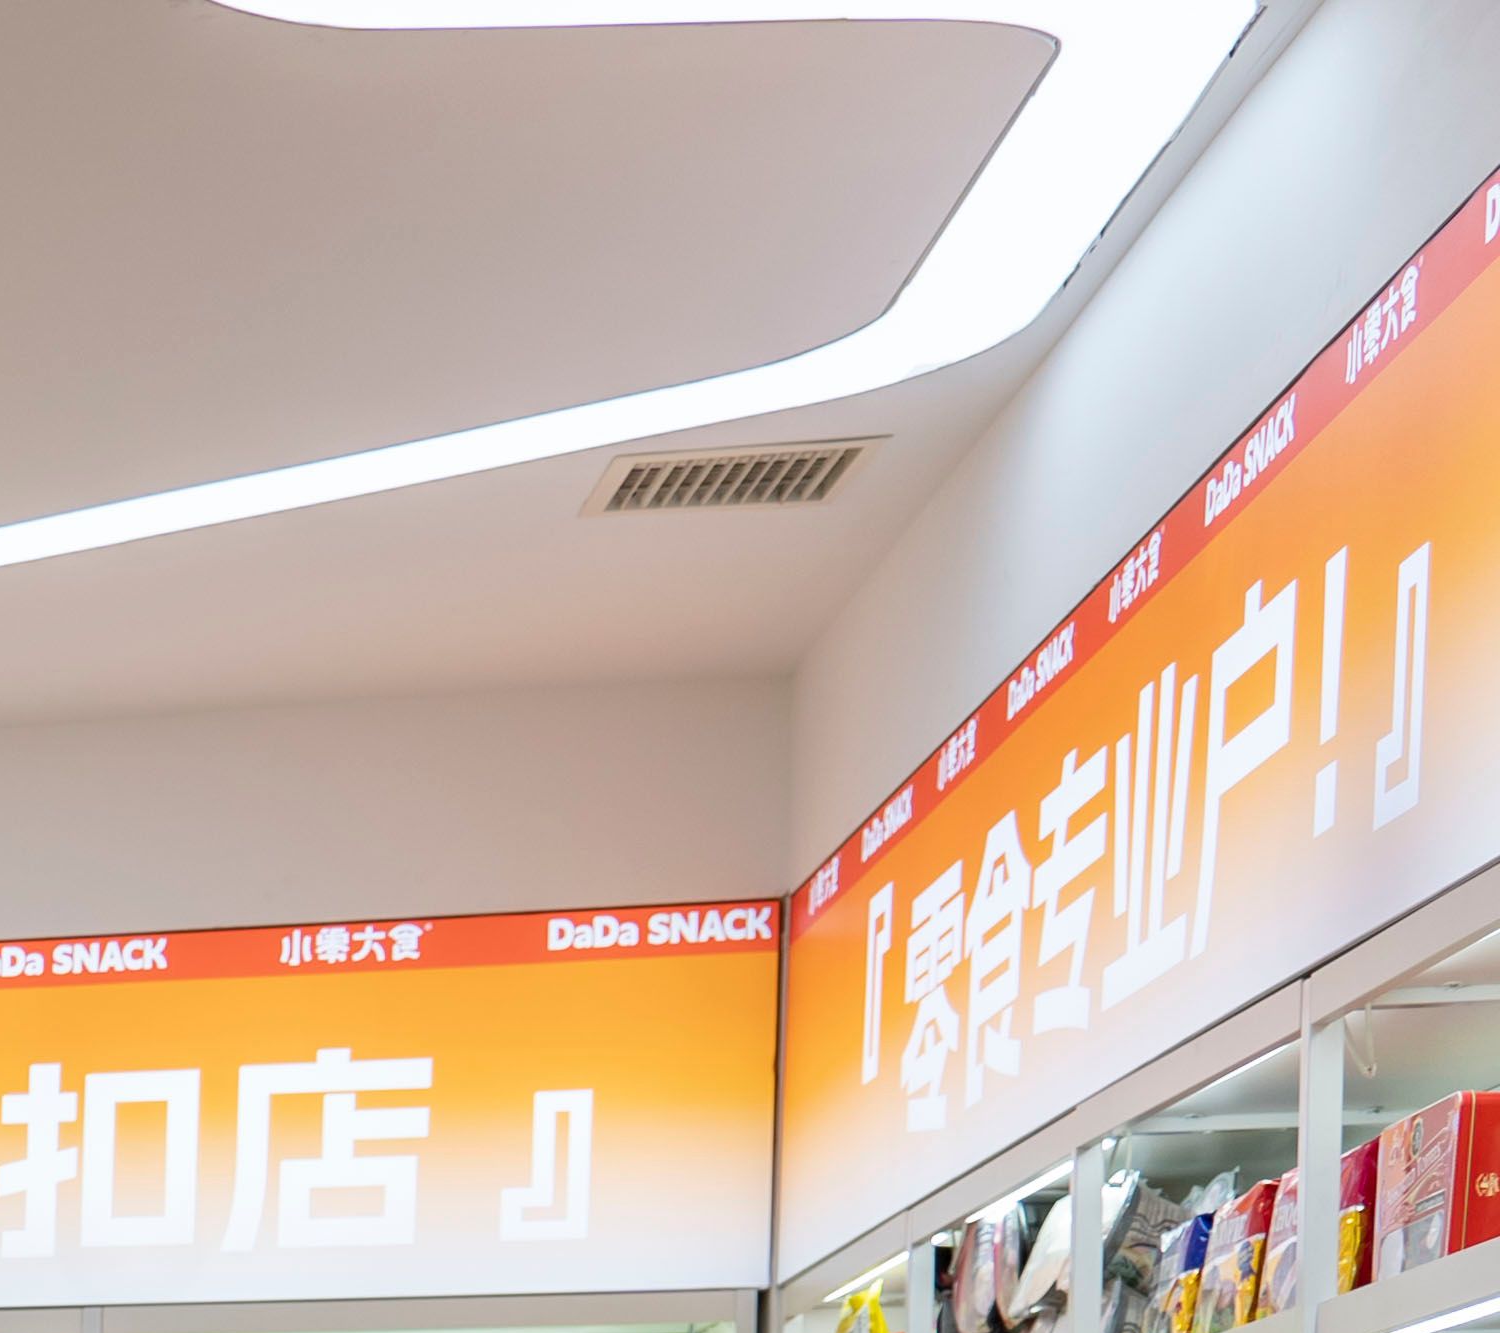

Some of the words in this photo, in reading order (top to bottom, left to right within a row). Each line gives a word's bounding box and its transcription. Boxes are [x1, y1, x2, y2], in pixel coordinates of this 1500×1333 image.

[1345, 265, 1419, 384] 小零大食
[281, 925, 423, 966] 小零大食
[547, 915, 641, 951] DaDa
[647, 908, 772, 946] SNACK
[52, 939, 167, 974] SNACK
